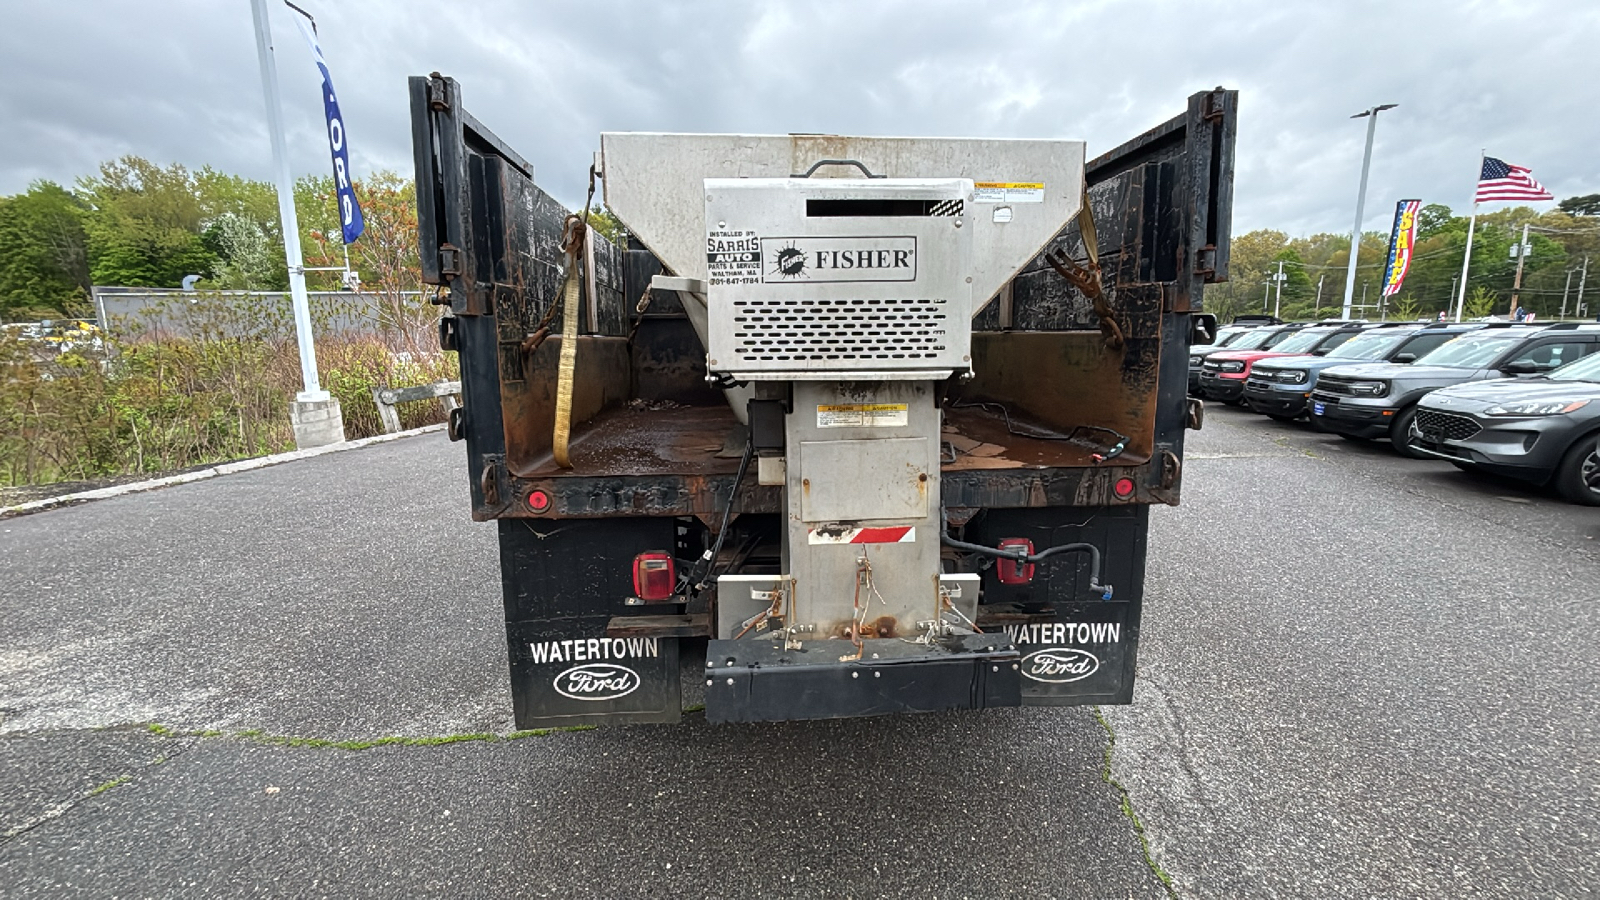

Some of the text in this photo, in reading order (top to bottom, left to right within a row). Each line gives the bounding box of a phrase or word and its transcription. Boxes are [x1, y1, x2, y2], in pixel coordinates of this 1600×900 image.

[707, 236, 759, 252] SARRIS
[1389, 212, 1414, 285] SALE
[714, 253, 753, 263] AUTO
[729, 262, 734, 270] &
[1003, 622, 1120, 644] WATERTOWN
[530, 637, 658, 664] WATERTOWN
[1031, 654, 1091, 675] Ford
[567, 670, 631, 693] Ford
